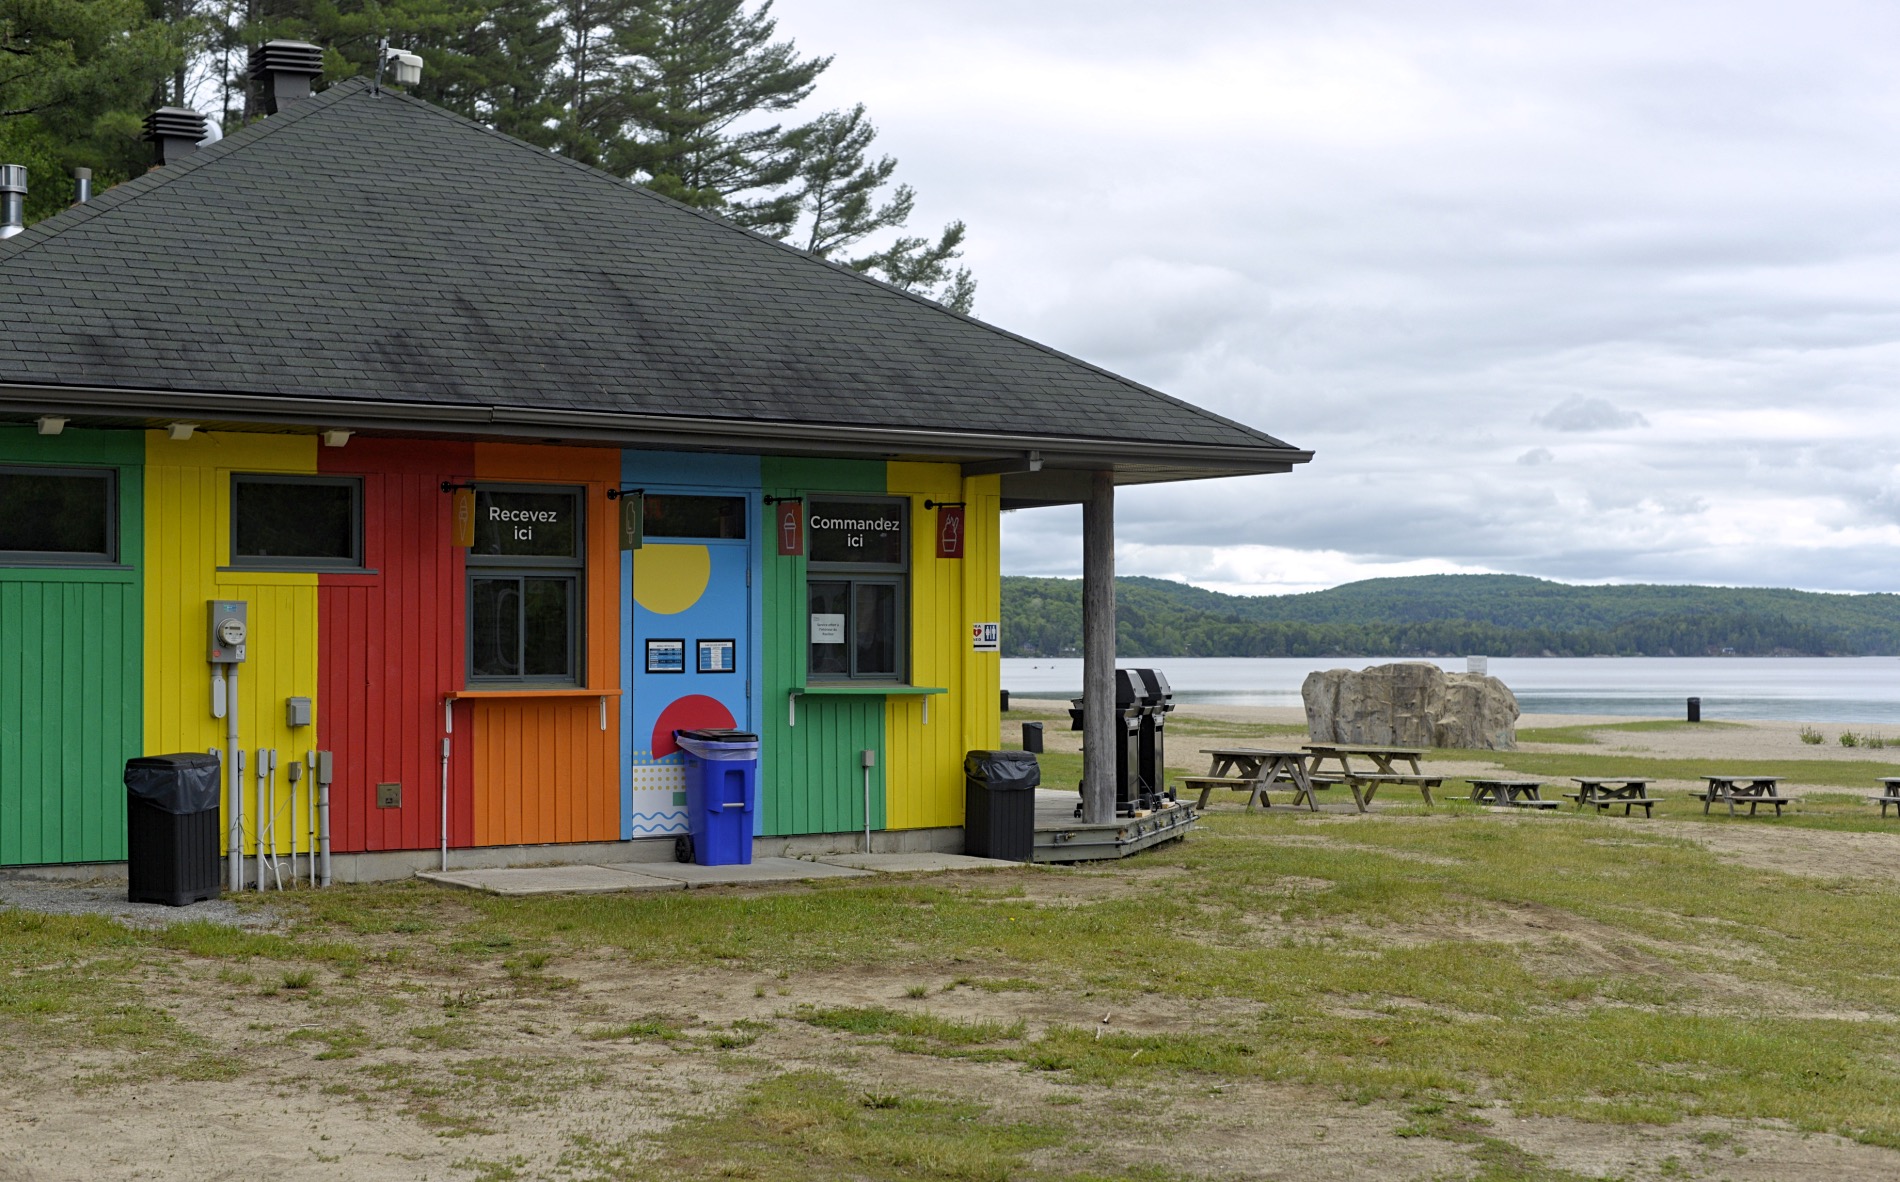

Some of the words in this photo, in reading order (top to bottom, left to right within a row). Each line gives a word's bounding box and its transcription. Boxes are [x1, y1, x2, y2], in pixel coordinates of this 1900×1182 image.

[489, 506, 557, 522] Recevez
[810, 515, 900, 531] Commandez
[514, 525, 532, 540] ici
[847, 533, 863, 547] ici
